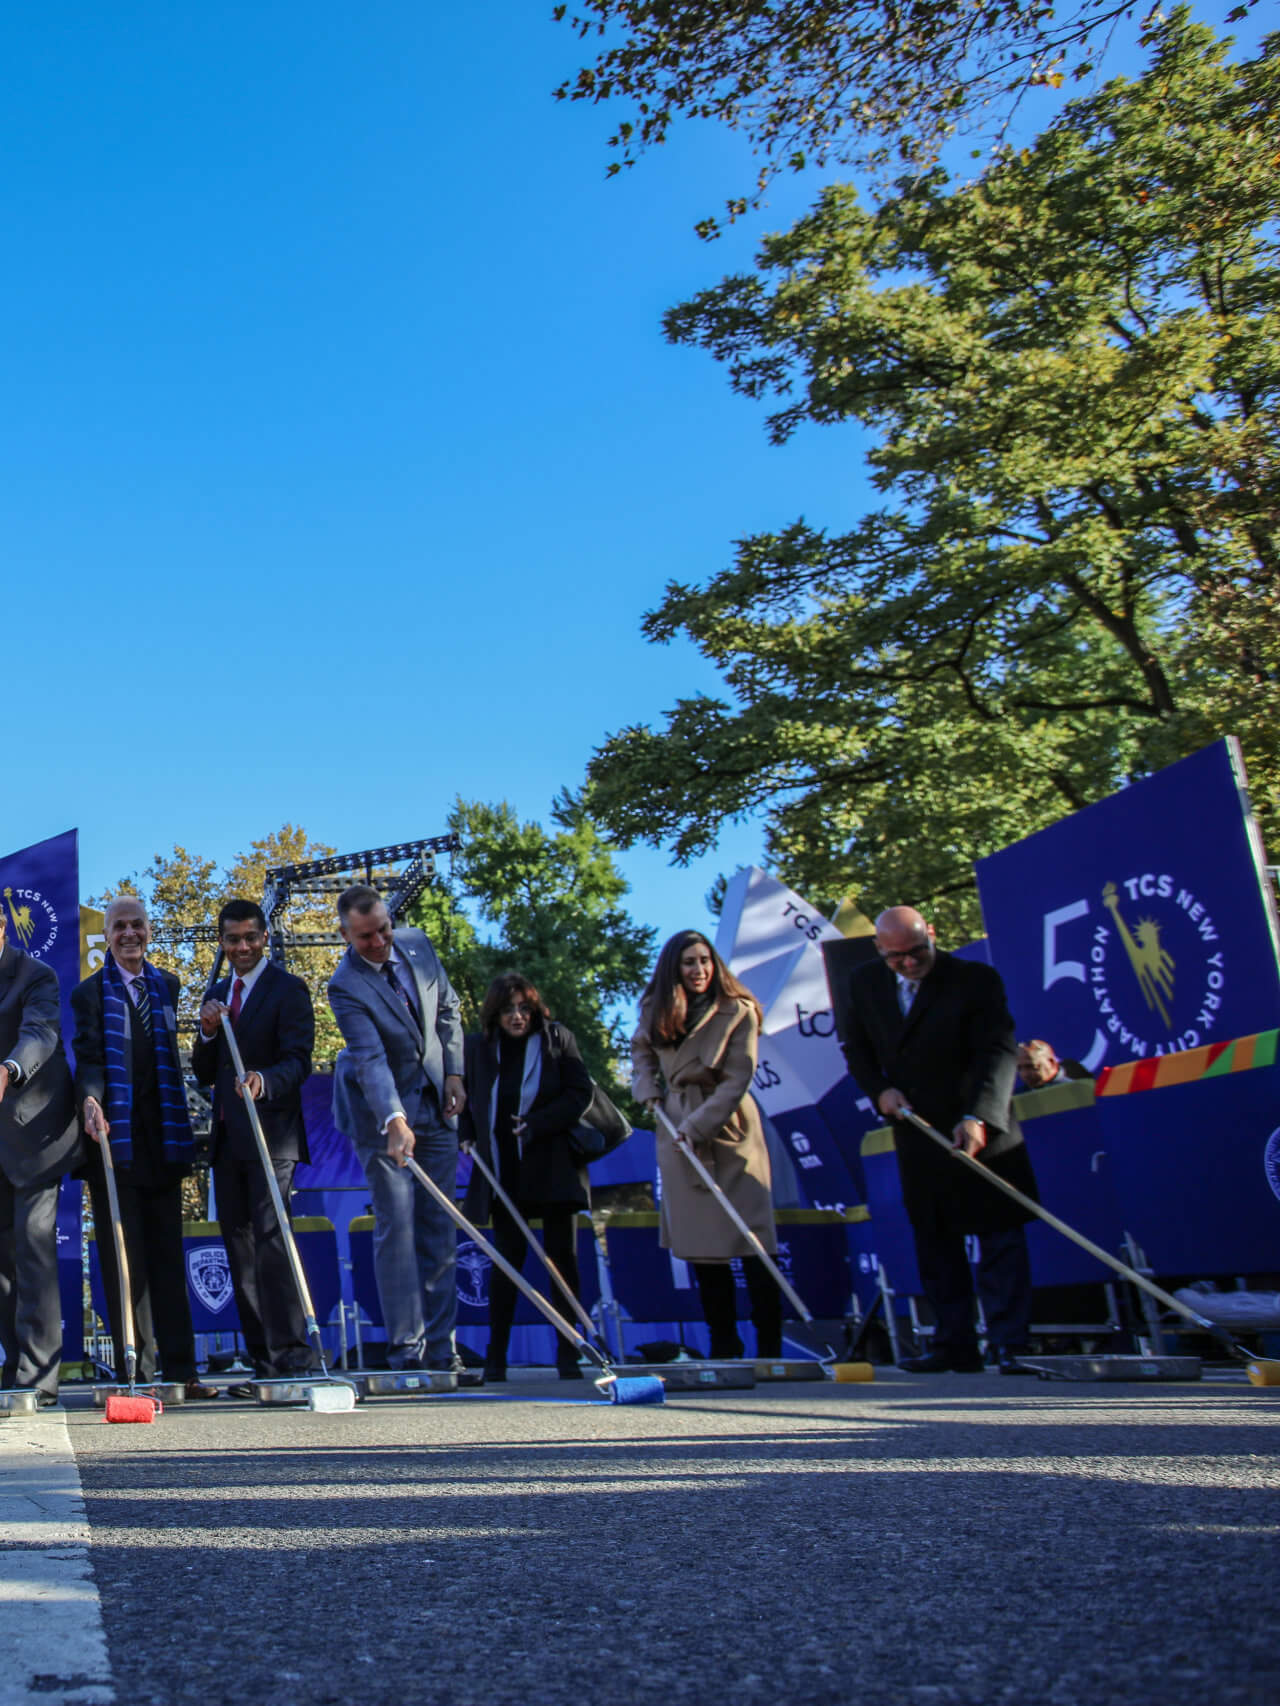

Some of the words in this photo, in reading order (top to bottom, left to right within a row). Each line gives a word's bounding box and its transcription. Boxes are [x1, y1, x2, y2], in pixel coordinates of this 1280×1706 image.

[16, 888, 41, 902] TCS
[1123, 873, 1174, 900] TCS
[41, 900, 58, 923] NEW
[782, 901, 823, 941] TCS
[1175, 889, 1219, 941] NEW
[41, 926, 59, 953] YORK
[1091, 925, 1147, 1057] MARATHON
[1195, 952, 1224, 1029] YORK
[796, 1002, 837, 1038] tc
[1154, 1029, 1200, 1057] CITY
